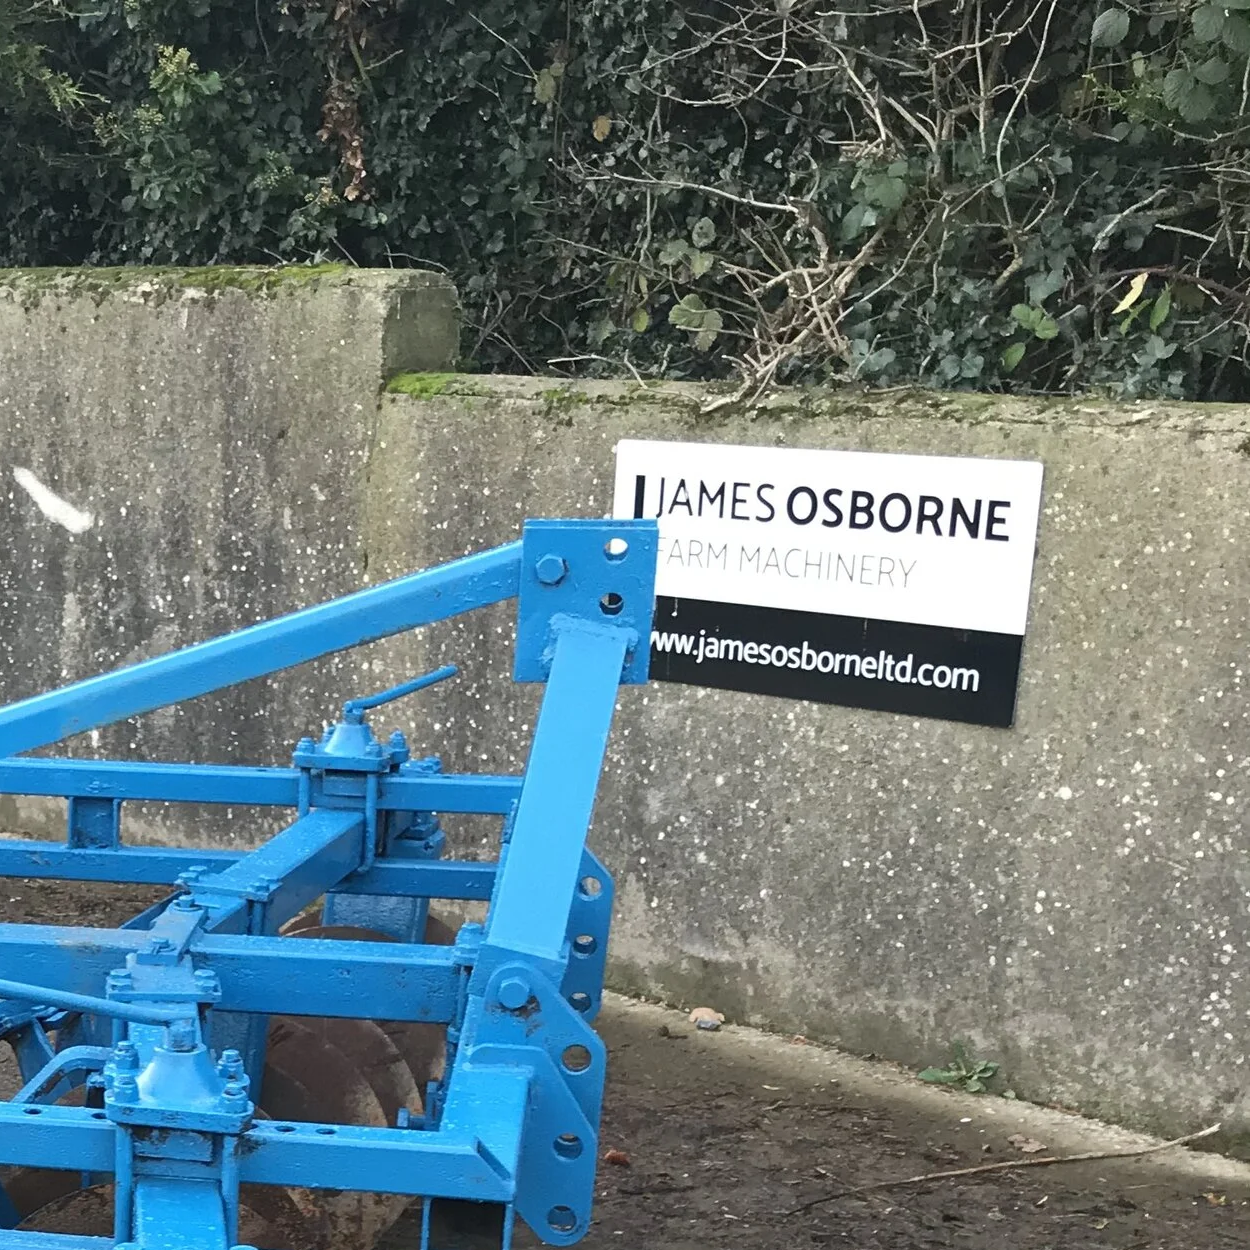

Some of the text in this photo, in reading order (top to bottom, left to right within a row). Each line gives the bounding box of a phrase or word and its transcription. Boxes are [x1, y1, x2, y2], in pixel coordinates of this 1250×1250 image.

[656, 476, 1011, 542] JAMES OSBORNE
[739, 545, 917, 588] MACHINERY
[649, 628, 980, 692] ww.jamesosborneltd.com
